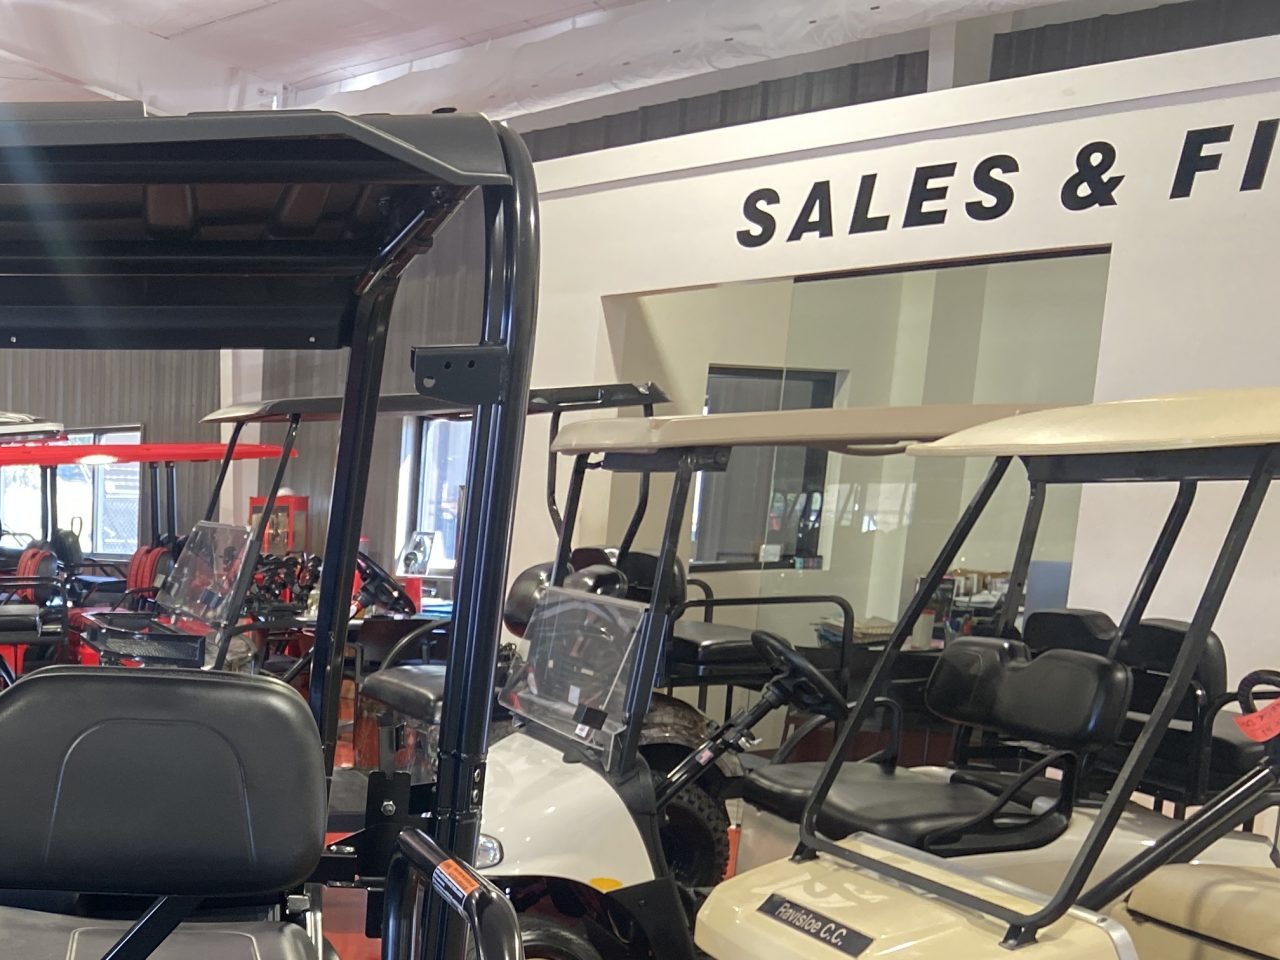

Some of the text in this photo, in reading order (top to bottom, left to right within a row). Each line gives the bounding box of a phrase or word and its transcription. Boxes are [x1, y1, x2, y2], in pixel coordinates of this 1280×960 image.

[736, 117, 1280, 248] SALES & FI
[775, 903, 847, 946] Ravisloe C.C.
